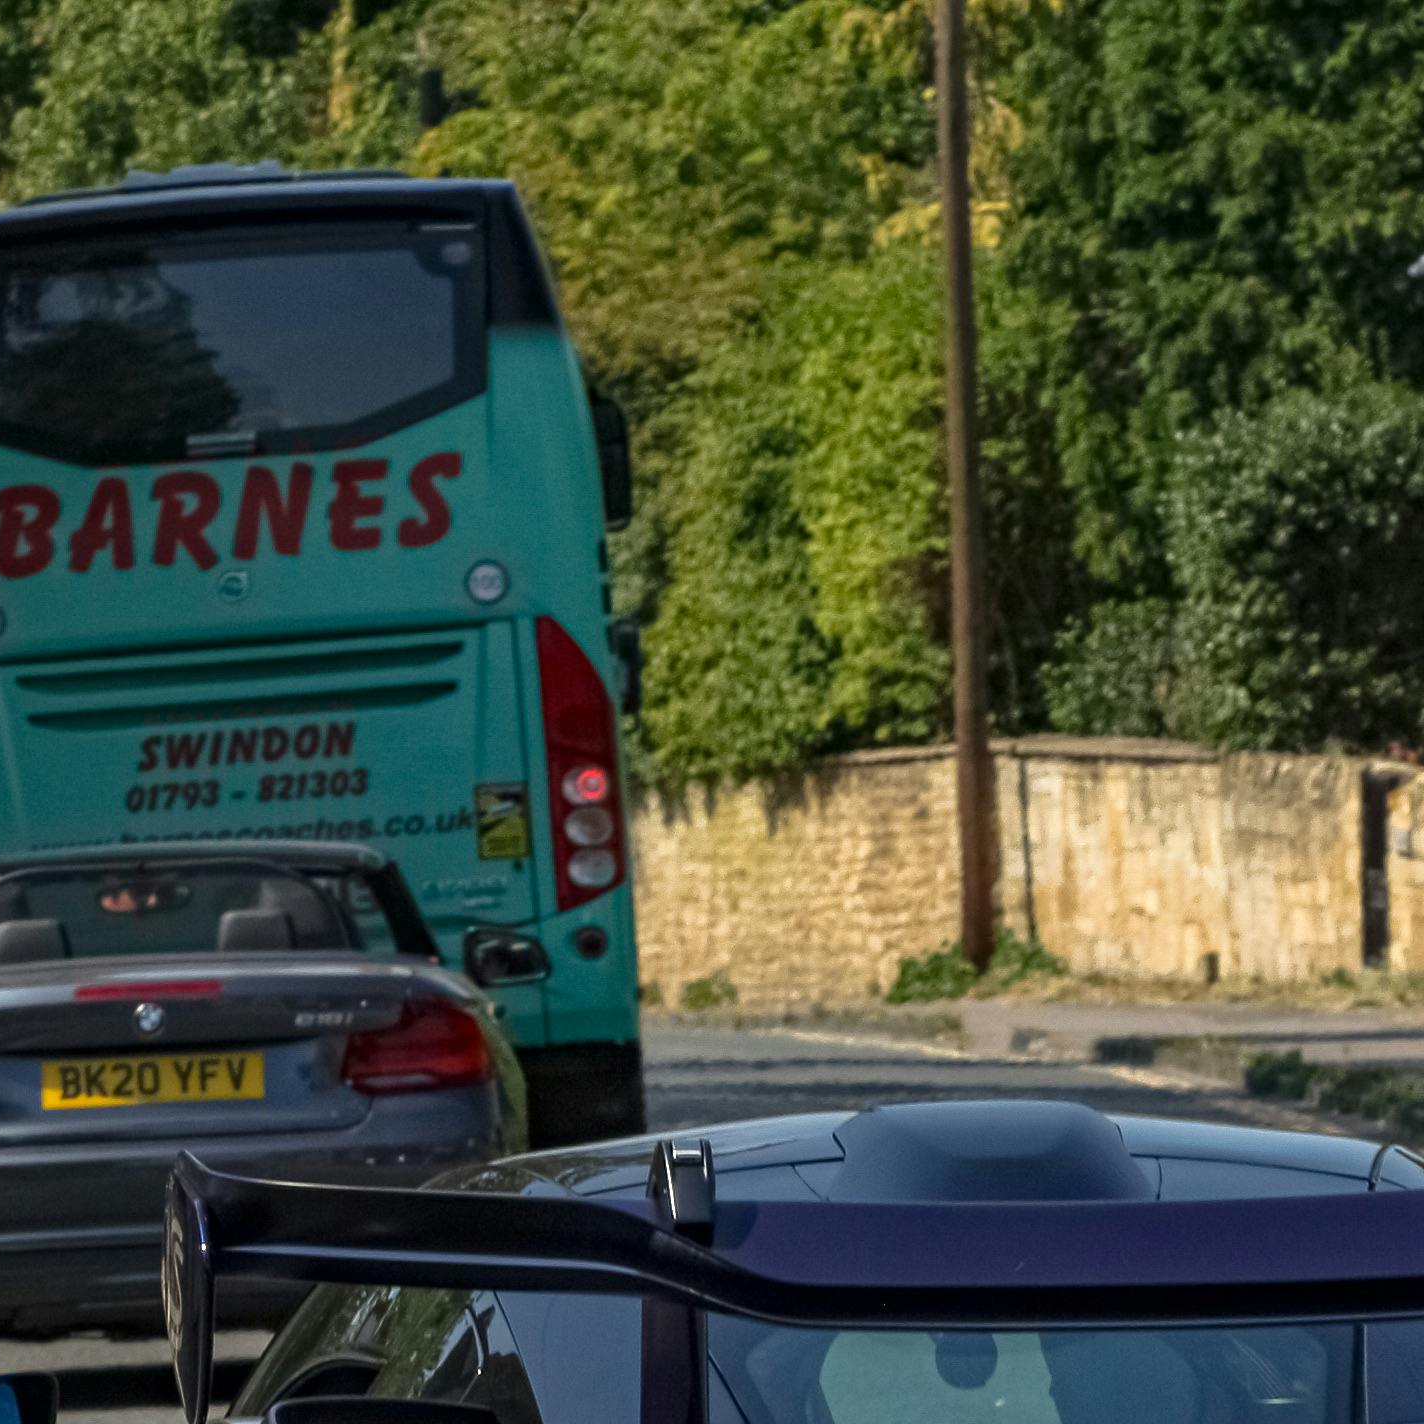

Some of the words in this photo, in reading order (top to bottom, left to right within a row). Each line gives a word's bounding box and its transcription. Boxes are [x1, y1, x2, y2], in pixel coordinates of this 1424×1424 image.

[138, 721, 357, 772] SWINDON
[126, 780, 221, 813] 01793
[258, 767, 370, 804] 821303
[60, 1058, 162, 1099] BK20
[174, 1055, 249, 1095] YFV
